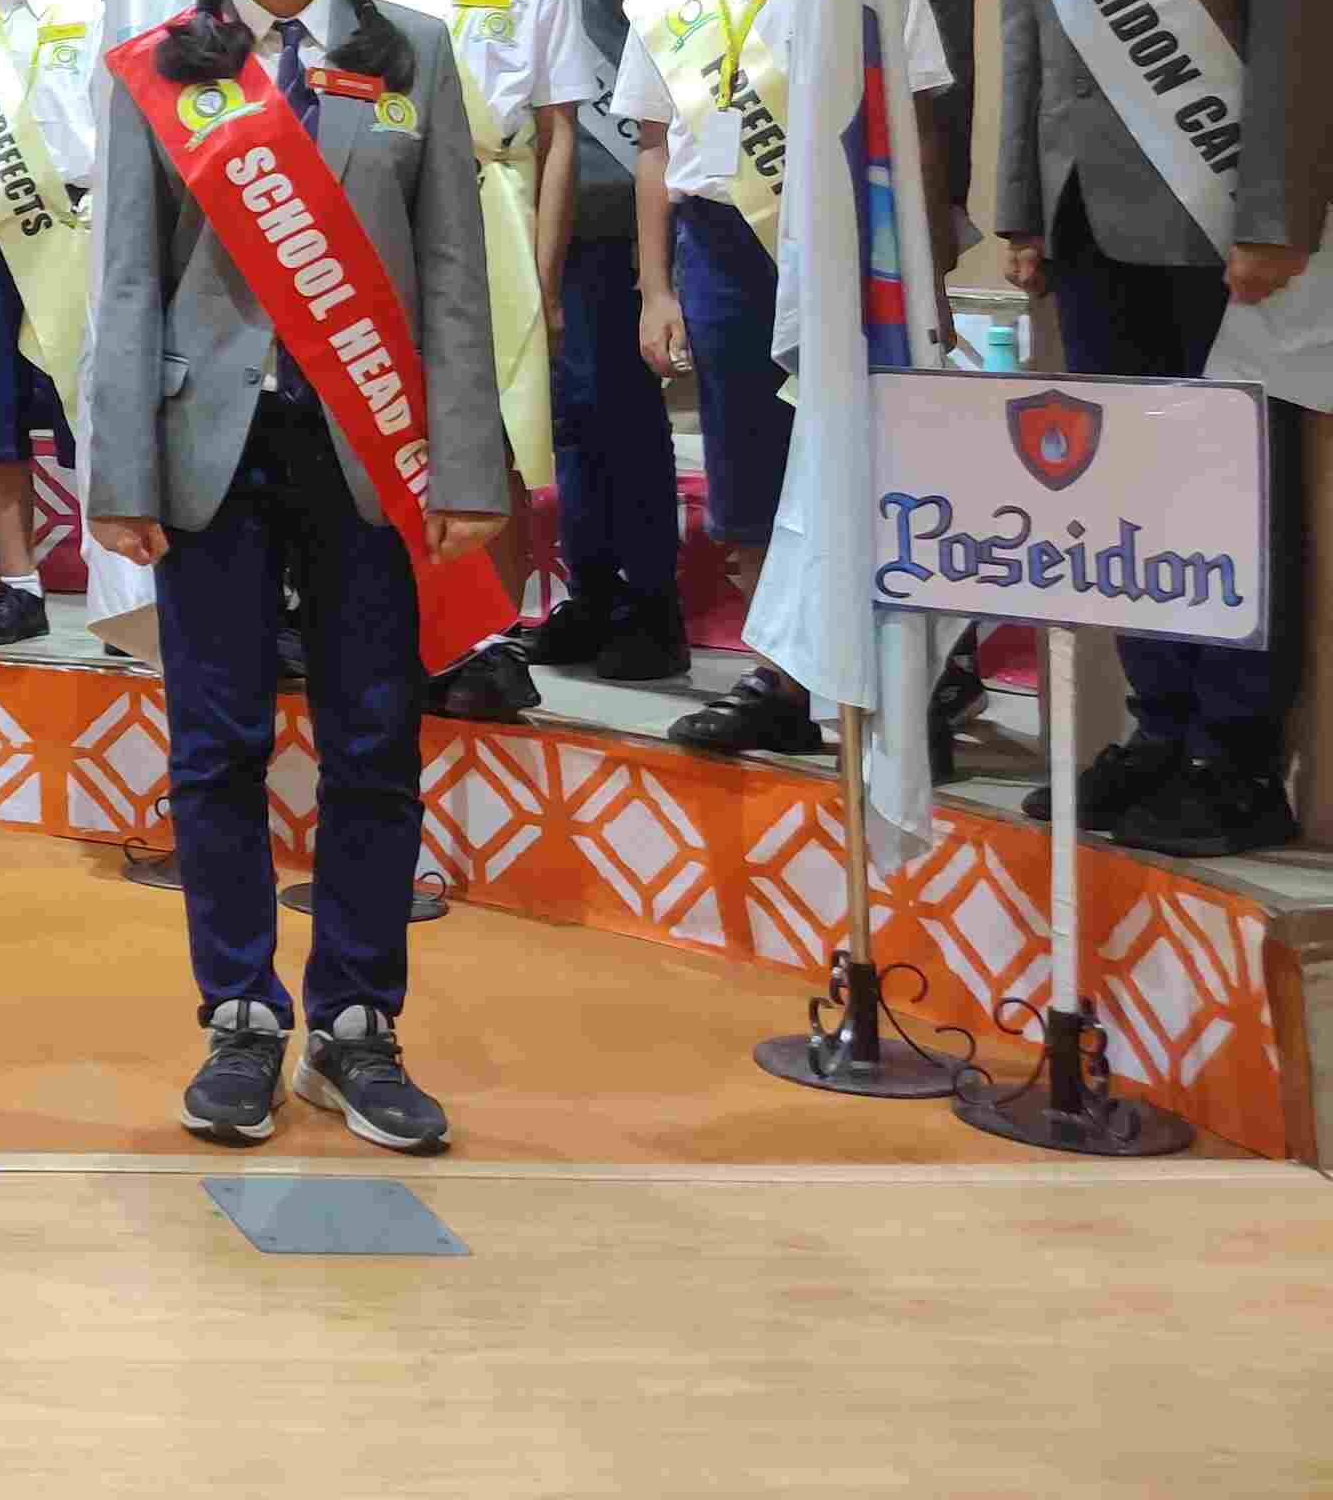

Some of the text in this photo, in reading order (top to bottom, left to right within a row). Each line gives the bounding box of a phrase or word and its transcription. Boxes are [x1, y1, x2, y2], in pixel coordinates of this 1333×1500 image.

[225, 146, 356, 321] SCHOOL
[329, 317, 412, 436] HEAD
[875, 491, 1244, 607] Poseidon
